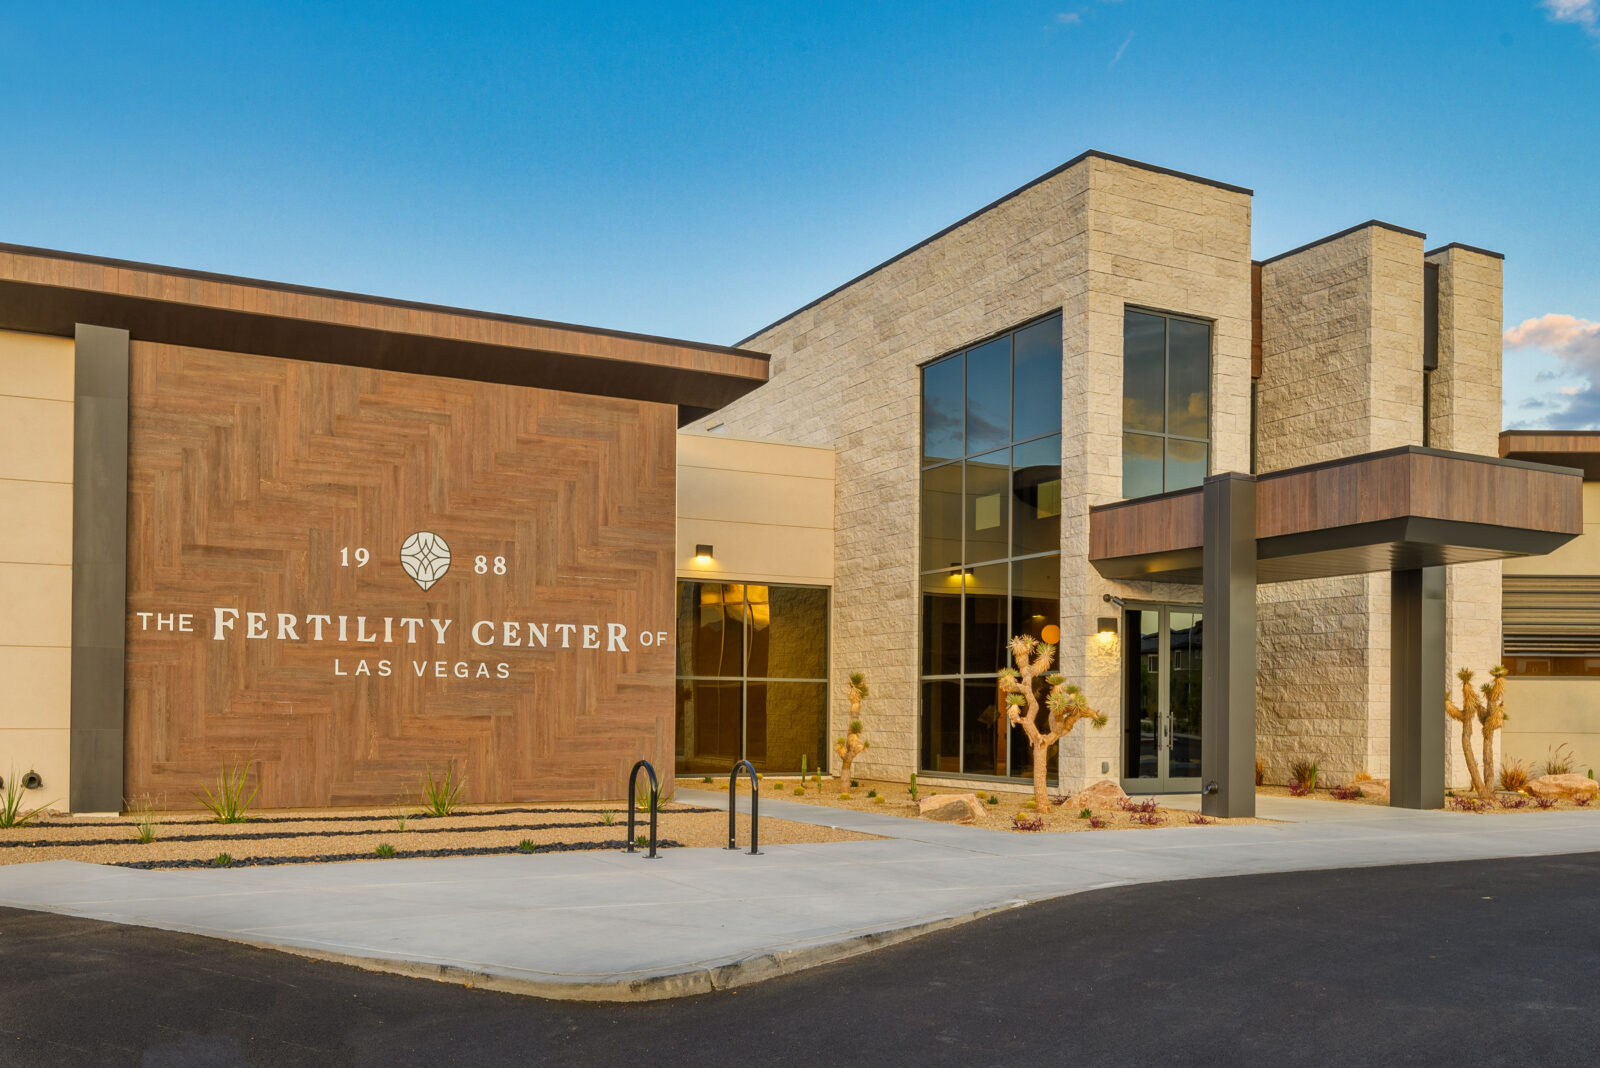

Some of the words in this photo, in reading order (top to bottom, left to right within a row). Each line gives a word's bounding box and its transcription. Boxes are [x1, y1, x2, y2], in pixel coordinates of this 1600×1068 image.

[340, 547, 370, 568] 19
[474, 554, 507, 576] 88
[136, 612, 194, 632] THE
[212, 607, 453, 645] FERTILITY
[471, 619, 630, 652] CENTER
[639, 630, 668, 647] OF
[334, 658, 392, 677] LAS
[413, 660, 510, 679] VEGAS
